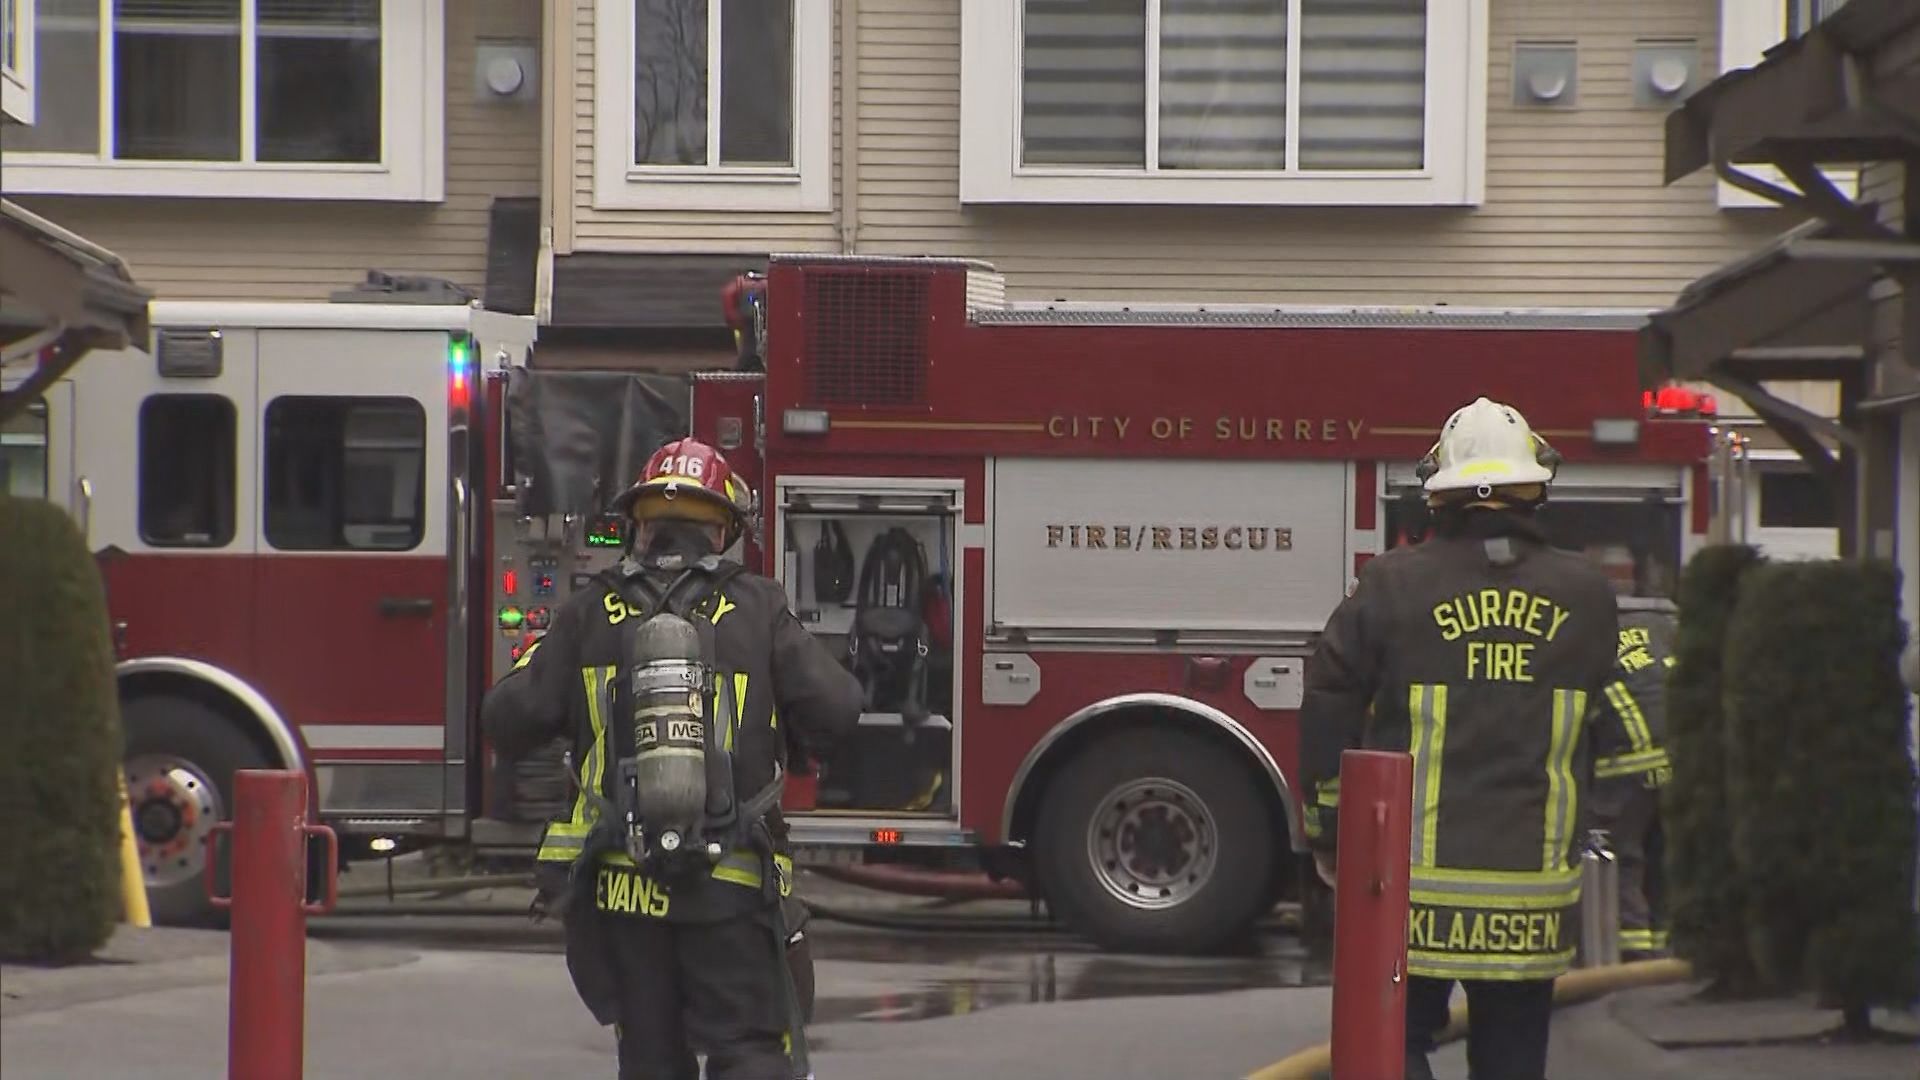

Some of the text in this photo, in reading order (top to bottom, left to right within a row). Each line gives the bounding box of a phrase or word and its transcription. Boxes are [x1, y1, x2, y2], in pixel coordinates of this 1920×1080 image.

[1048, 415, 1364, 441] CITY OF SURREY
[659, 455, 704, 477] 416
[1046, 524, 1294, 551] FIRE/RESCUE
[1432, 588, 1570, 642] SURREY
[1467, 642, 1536, 682] FIRE
[596, 869, 670, 917] EVANS
[1408, 908, 1561, 951] KLAASSEN
